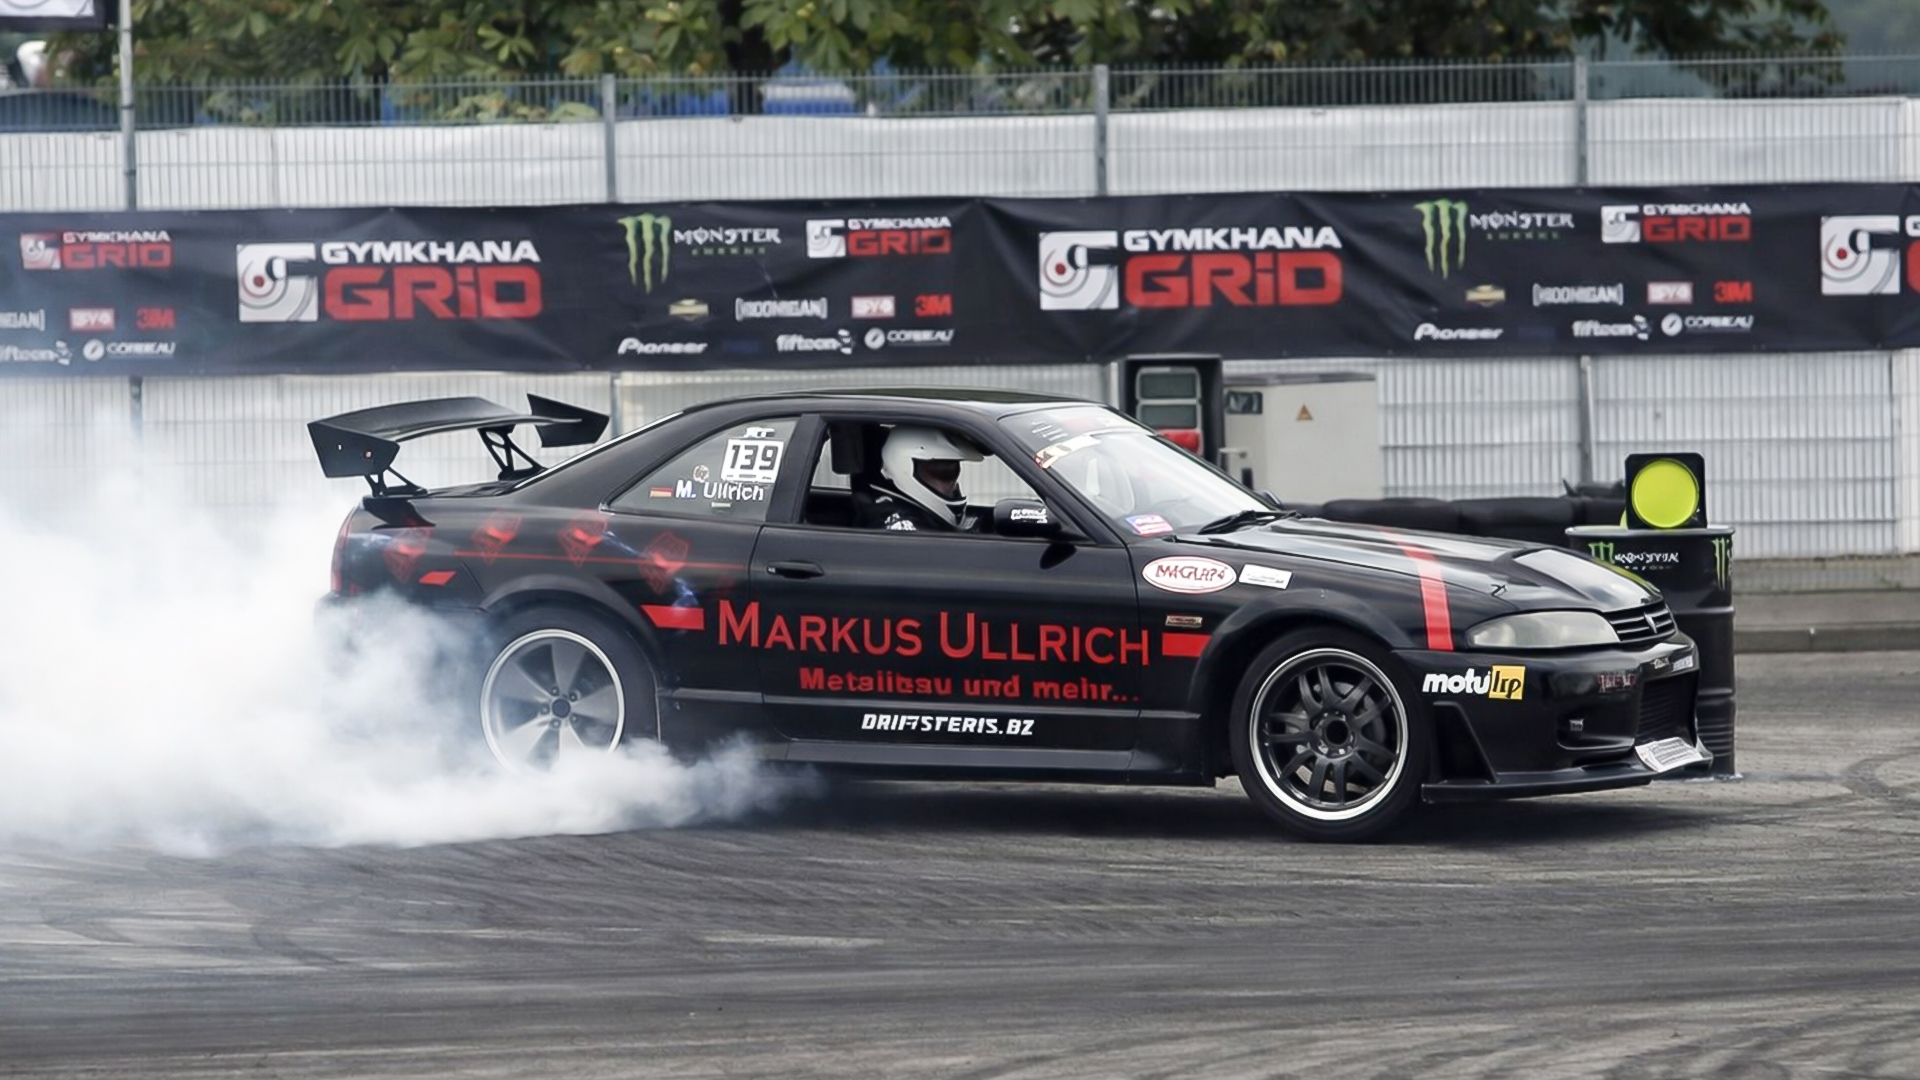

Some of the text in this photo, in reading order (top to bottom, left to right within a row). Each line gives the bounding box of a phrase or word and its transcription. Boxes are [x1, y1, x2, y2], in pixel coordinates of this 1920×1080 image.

[1470, 210, 1575, 230] MONSTER
[674, 226, 782, 245] MONSTER
[1123, 226, 1342, 251] GYMKHANA
[321, 240, 541, 264] GYMKHANA
[1714, 281, 1753, 303] 3M
[915, 295, 953, 317] 3M
[136, 308, 175, 330] 3M
[730, 444, 779, 470] 139
[676, 480, 764, 501] M. Ullrich
[719, 599, 1149, 666] MARKUS ULLRICH
[964, 675, 1021, 698] und
